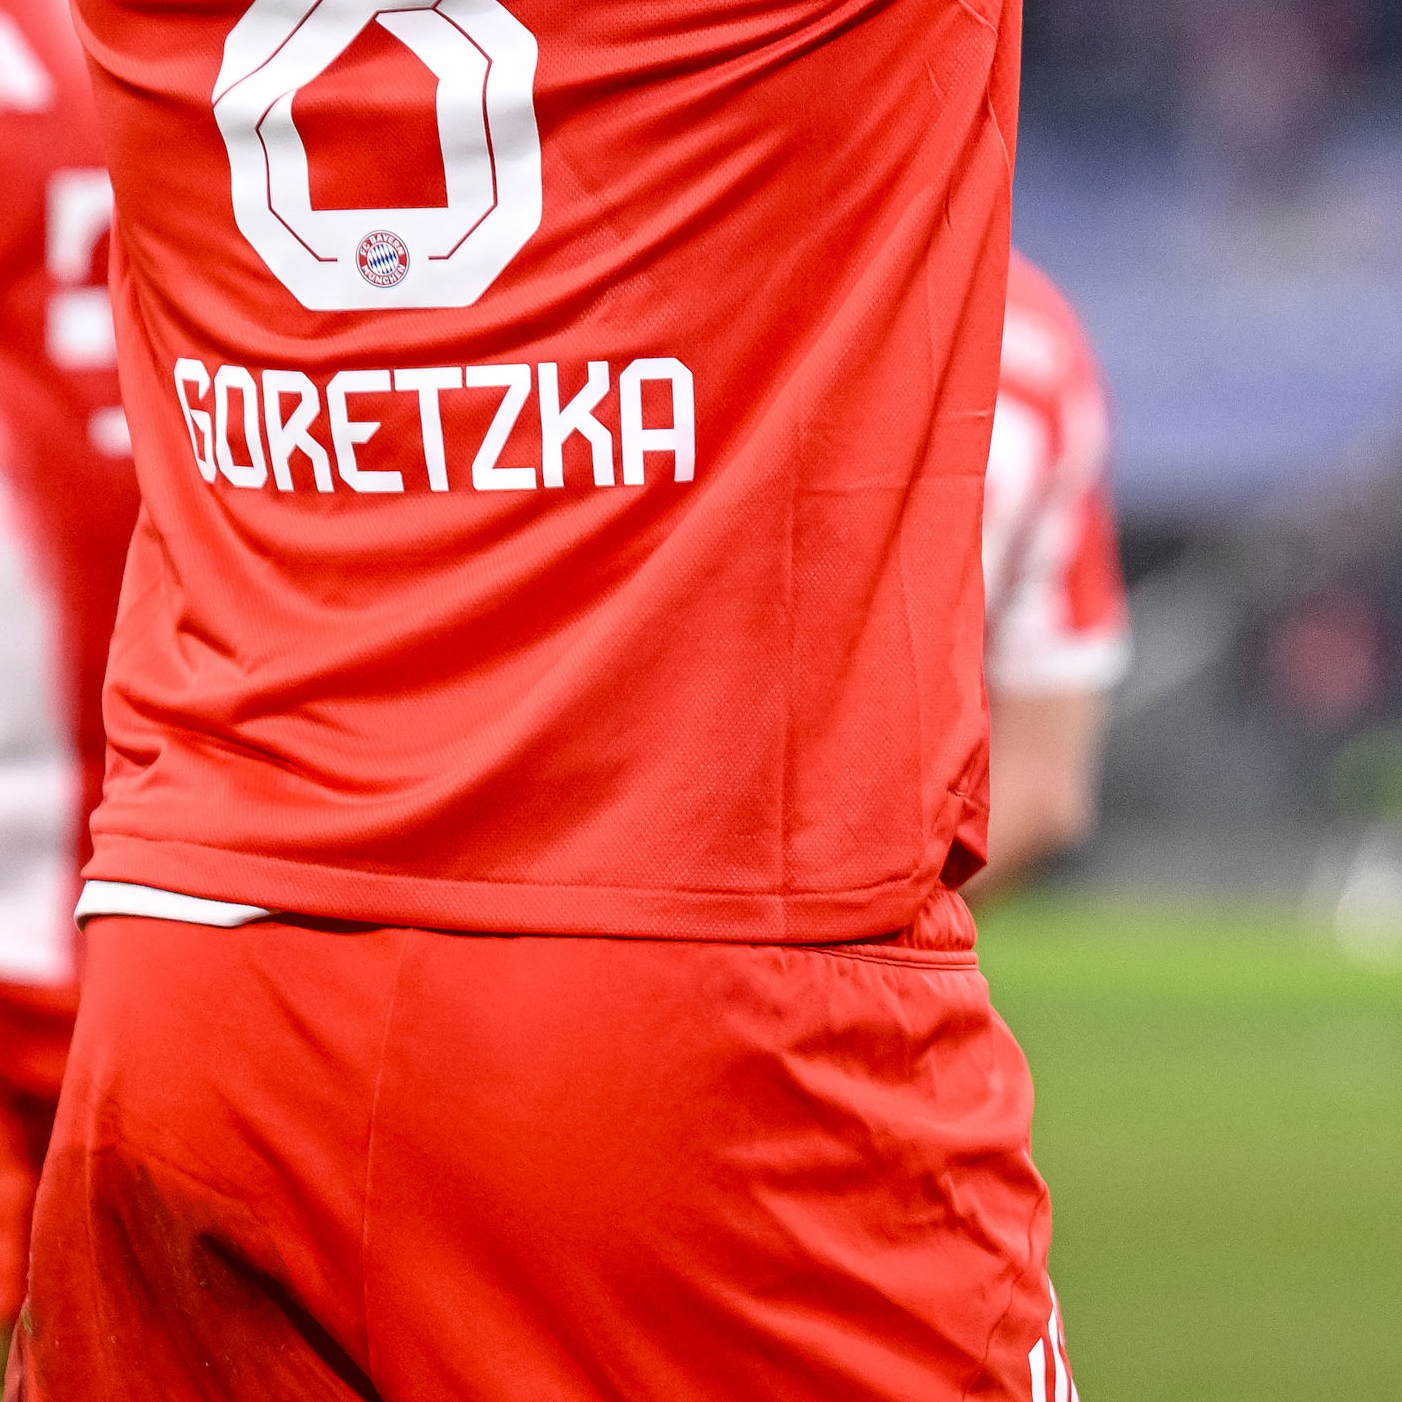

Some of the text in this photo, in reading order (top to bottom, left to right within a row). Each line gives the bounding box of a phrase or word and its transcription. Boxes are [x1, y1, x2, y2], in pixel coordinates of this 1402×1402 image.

[359, 233, 405, 255] FC BAYERN
[173, 356, 695, 493] GORETZKA
